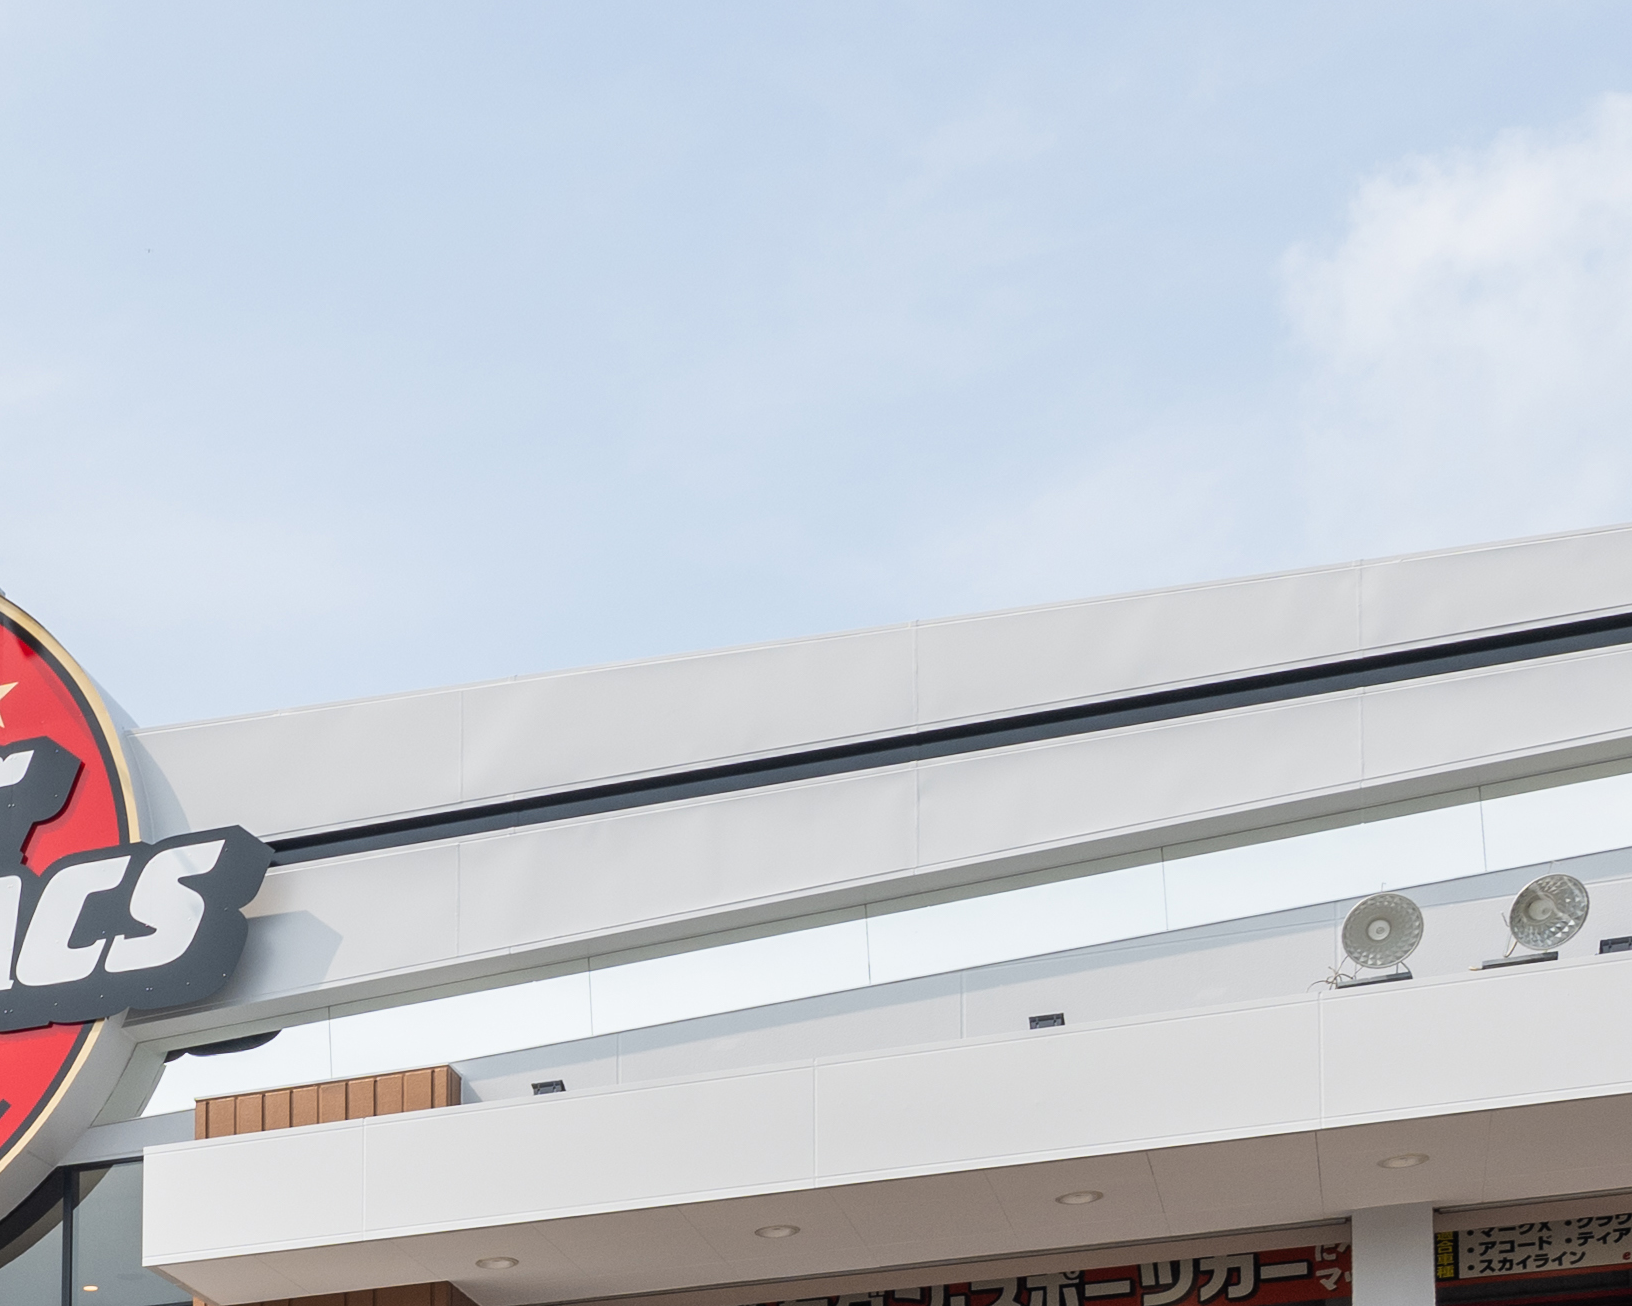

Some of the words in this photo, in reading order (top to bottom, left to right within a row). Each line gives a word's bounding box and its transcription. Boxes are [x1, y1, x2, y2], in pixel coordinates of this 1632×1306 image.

[1479, 1251, 1586, 1273] スカイライン
